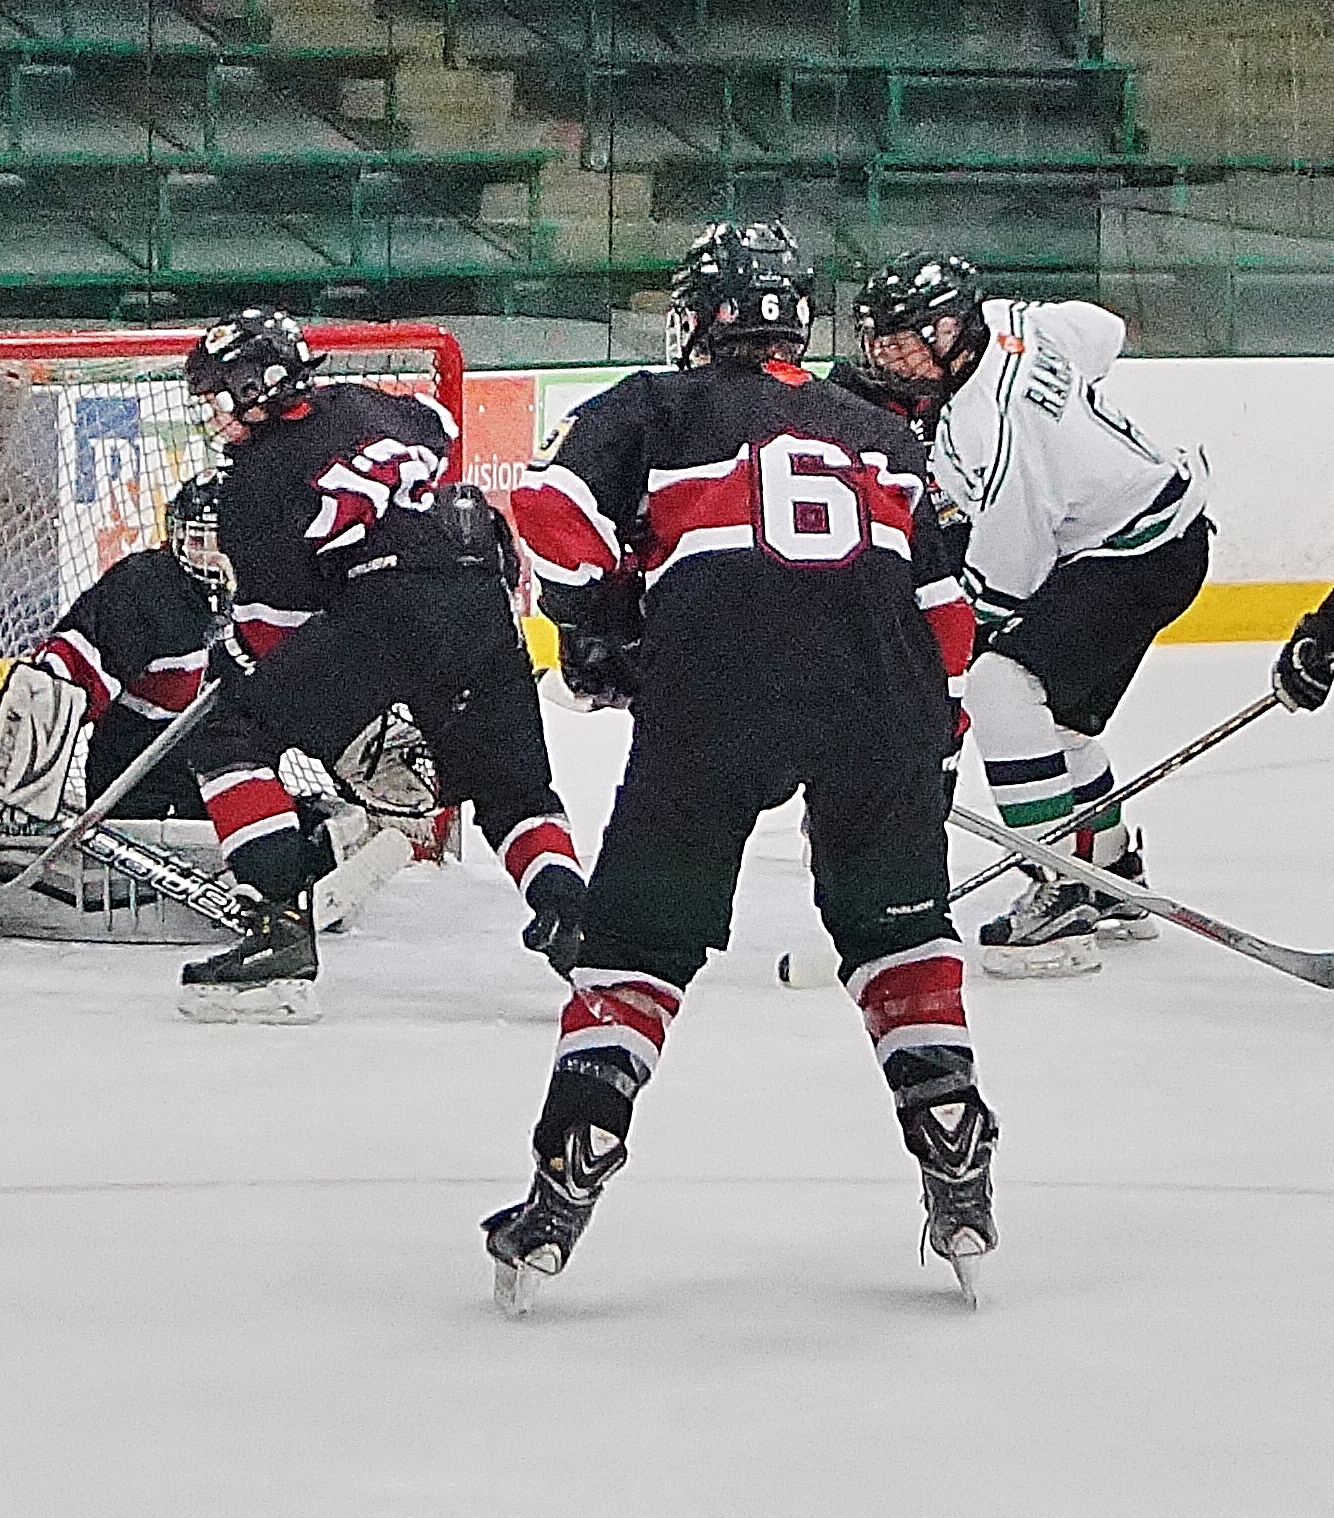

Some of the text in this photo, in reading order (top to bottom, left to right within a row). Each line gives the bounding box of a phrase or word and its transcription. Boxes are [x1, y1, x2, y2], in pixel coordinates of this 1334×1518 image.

[761, 293, 780, 322] 6
[462, 453, 526, 492] vision
[754, 427, 865, 566] 6
